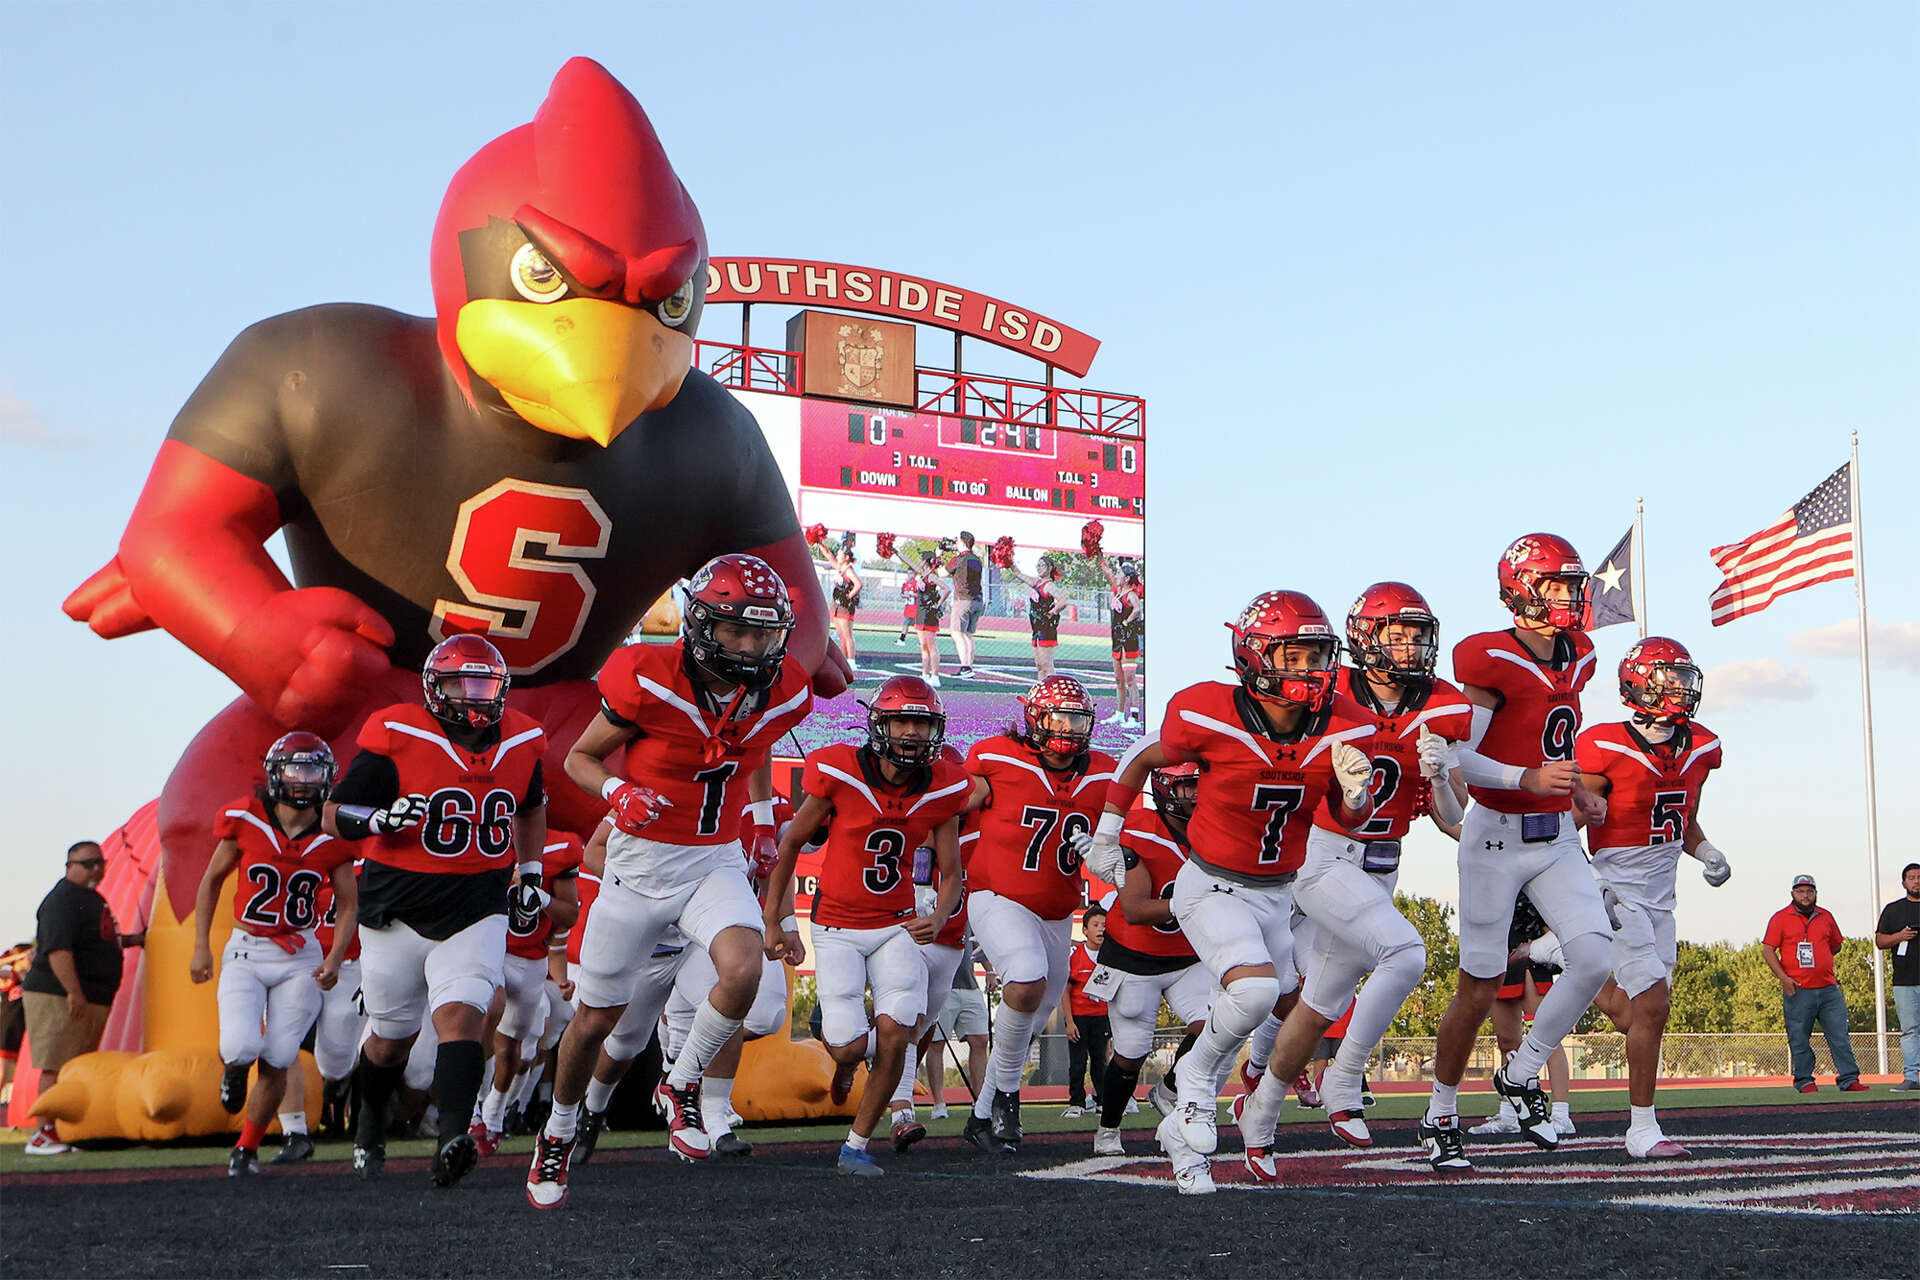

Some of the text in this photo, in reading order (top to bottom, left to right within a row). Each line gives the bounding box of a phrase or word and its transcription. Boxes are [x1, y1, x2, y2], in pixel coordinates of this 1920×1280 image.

[706, 262, 1063, 353] OUTHSIDE ISD
[870, 416, 886, 446] 0
[893, 451, 937, 469] 3 T.O.L.
[1121, 445, 1136, 473] 0
[860, 471, 896, 487] DOWN
[952, 481, 986, 496] TO GO
[1006, 485, 1048, 501] BALL ON
[1057, 471, 1099, 488] T.O.L. 3
[1099, 495, 1122, 509] QTR.
[428, 477, 613, 675] S
[1541, 705, 1577, 768] 9
[420, 787, 517, 858] 66
[692, 761, 739, 836] 1
[1251, 784, 1306, 865] 7
[1649, 791, 1688, 846] 5
[862, 829, 906, 895] 3
[1020, 805, 1091, 876] 78
[241, 863, 323, 929] 28
